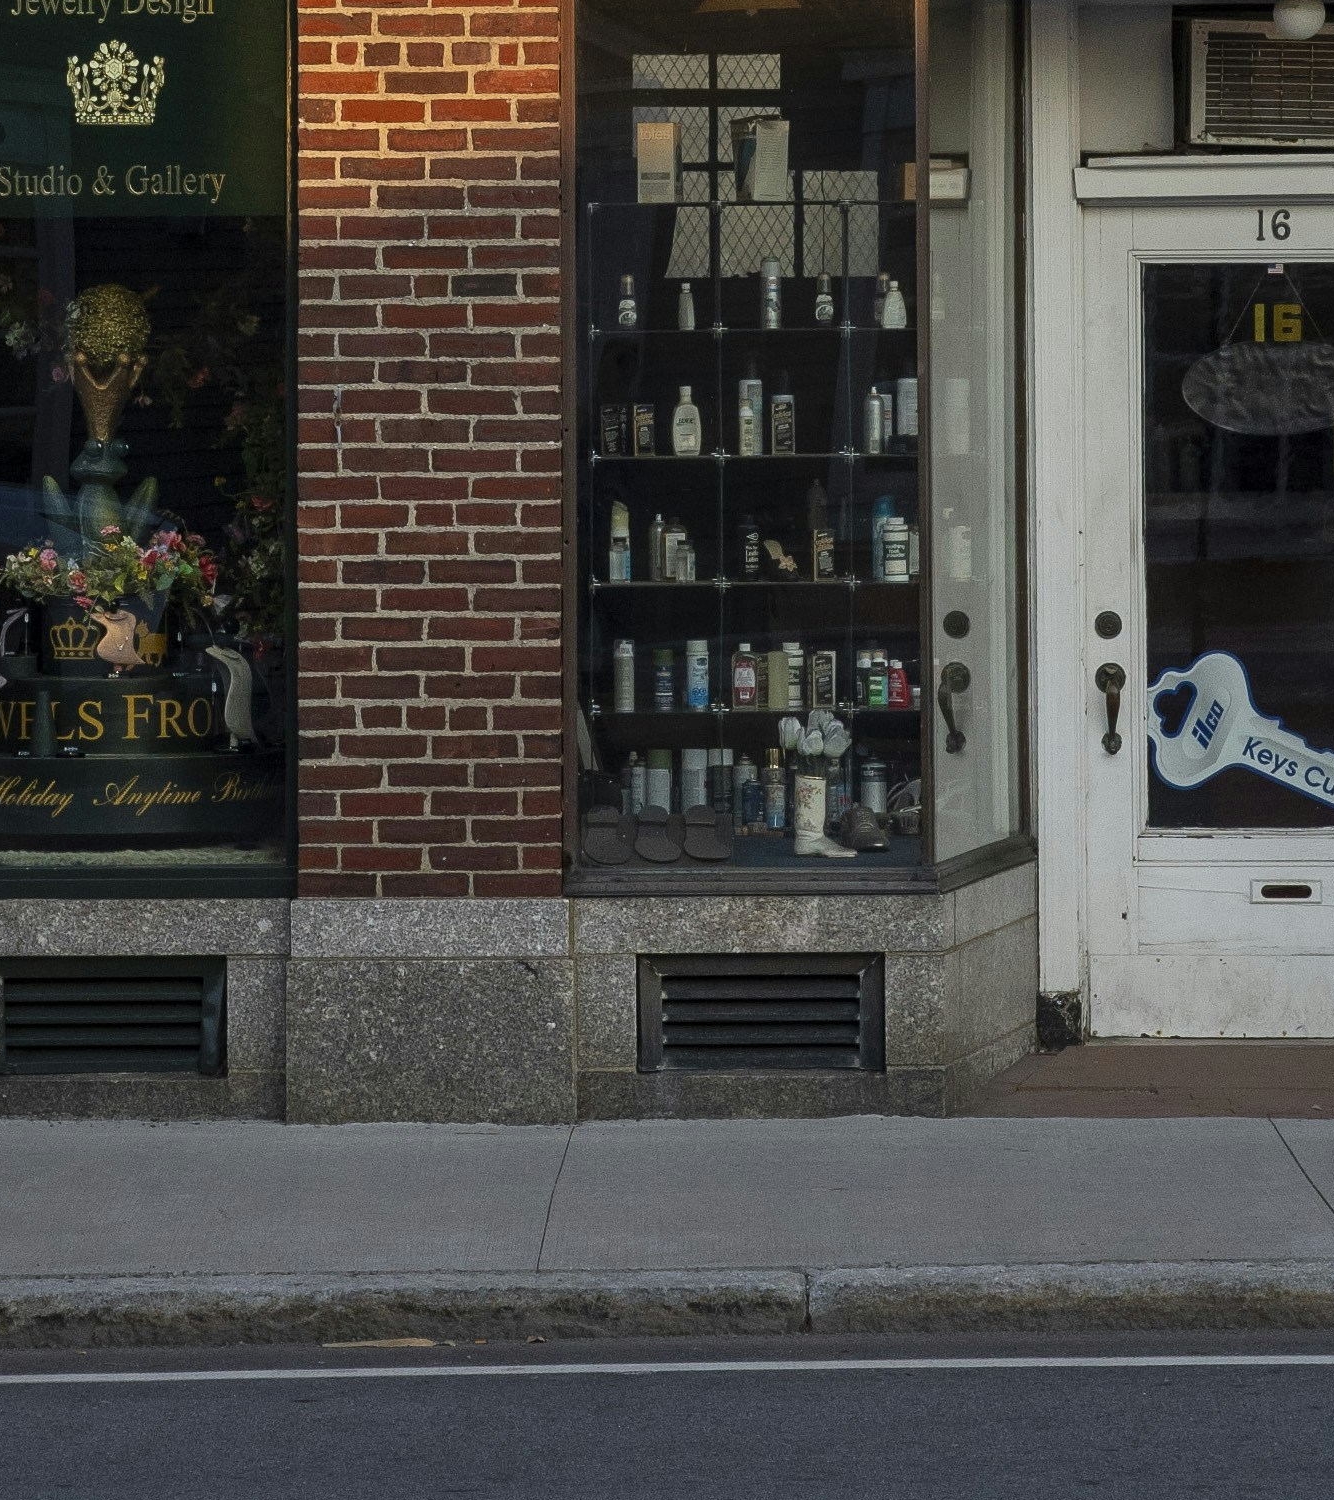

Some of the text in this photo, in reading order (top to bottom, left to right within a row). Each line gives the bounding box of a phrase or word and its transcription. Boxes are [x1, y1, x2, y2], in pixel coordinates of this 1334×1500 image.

[91, 165, 117, 197] &
[125, 165, 227, 204] Gallery
[1255, 208, 1292, 242] 16
[1253, 302, 1303, 343] 16
[1241, 735, 1298, 778] Keys
[92, 774, 203, 817] Anytime
